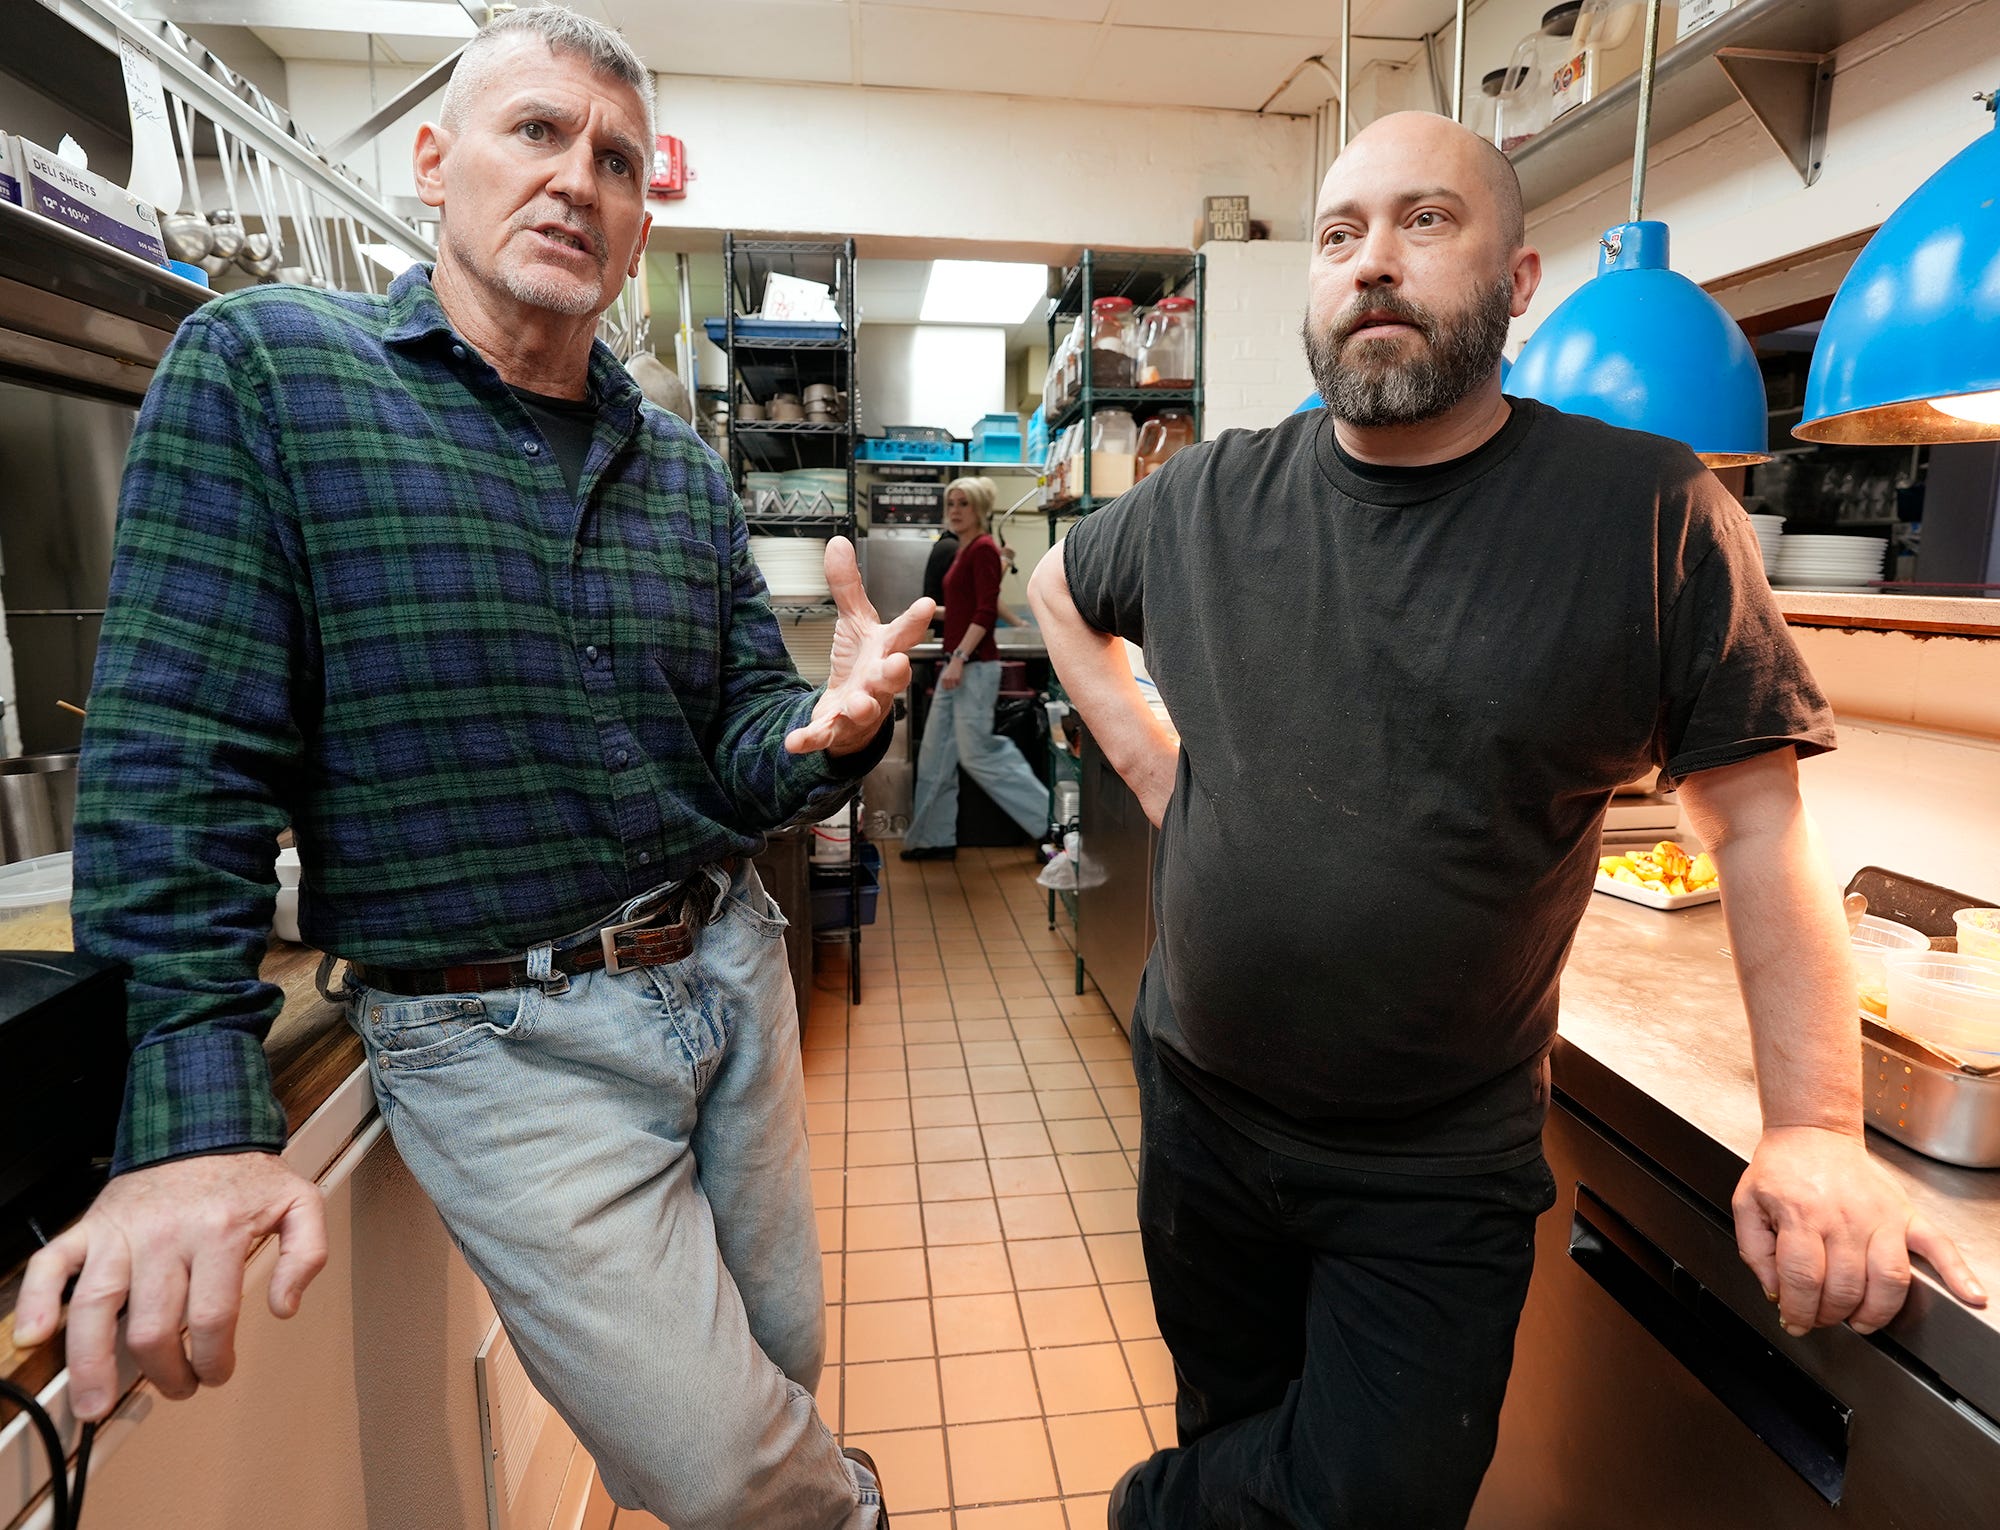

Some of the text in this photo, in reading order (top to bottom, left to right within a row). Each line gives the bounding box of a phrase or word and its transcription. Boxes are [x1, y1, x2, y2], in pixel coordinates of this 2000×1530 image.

[33, 159, 96, 197] DELI SHEETS
[1214, 222, 1244, 240] DAD
